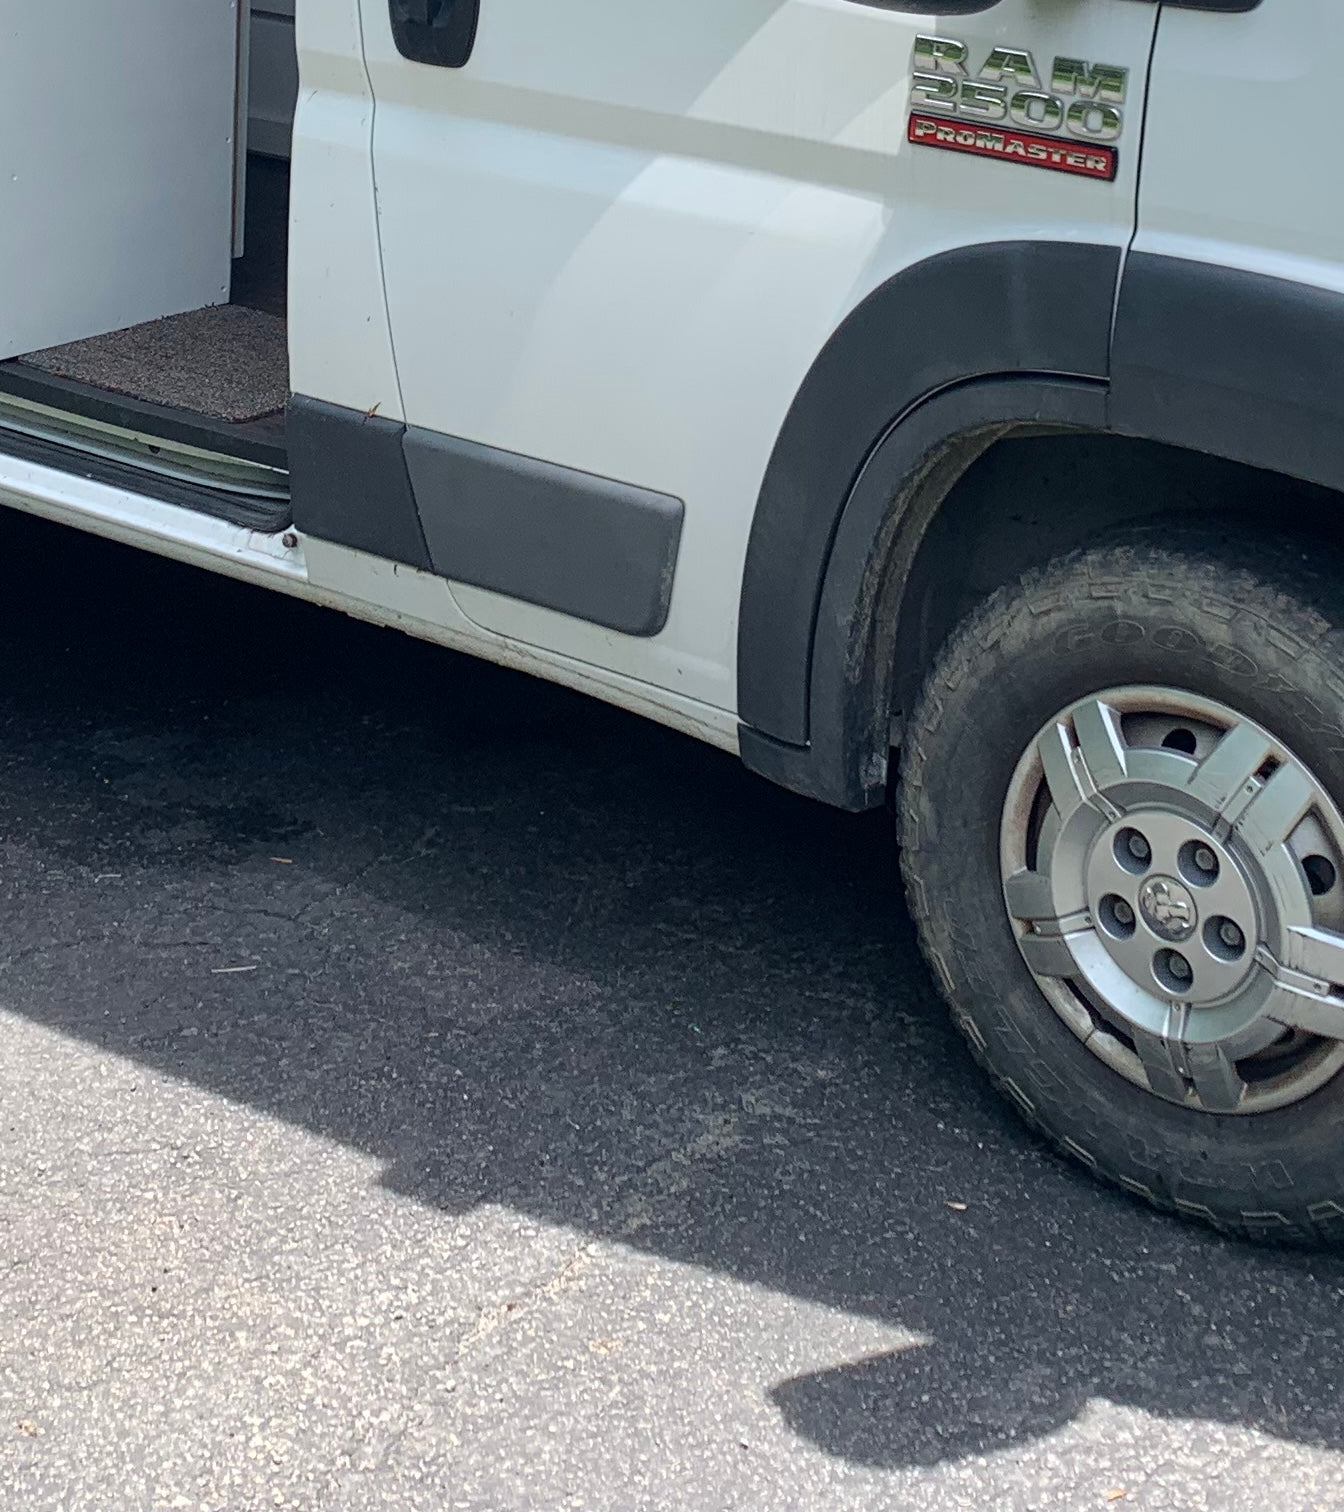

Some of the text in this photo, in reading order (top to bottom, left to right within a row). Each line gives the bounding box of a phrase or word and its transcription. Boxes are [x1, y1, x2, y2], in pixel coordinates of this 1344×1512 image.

[912, 33, 1130, 105] RAM
[909, 71, 1123, 141] 2500
[914, 119, 1107, 173] PROMASTER
